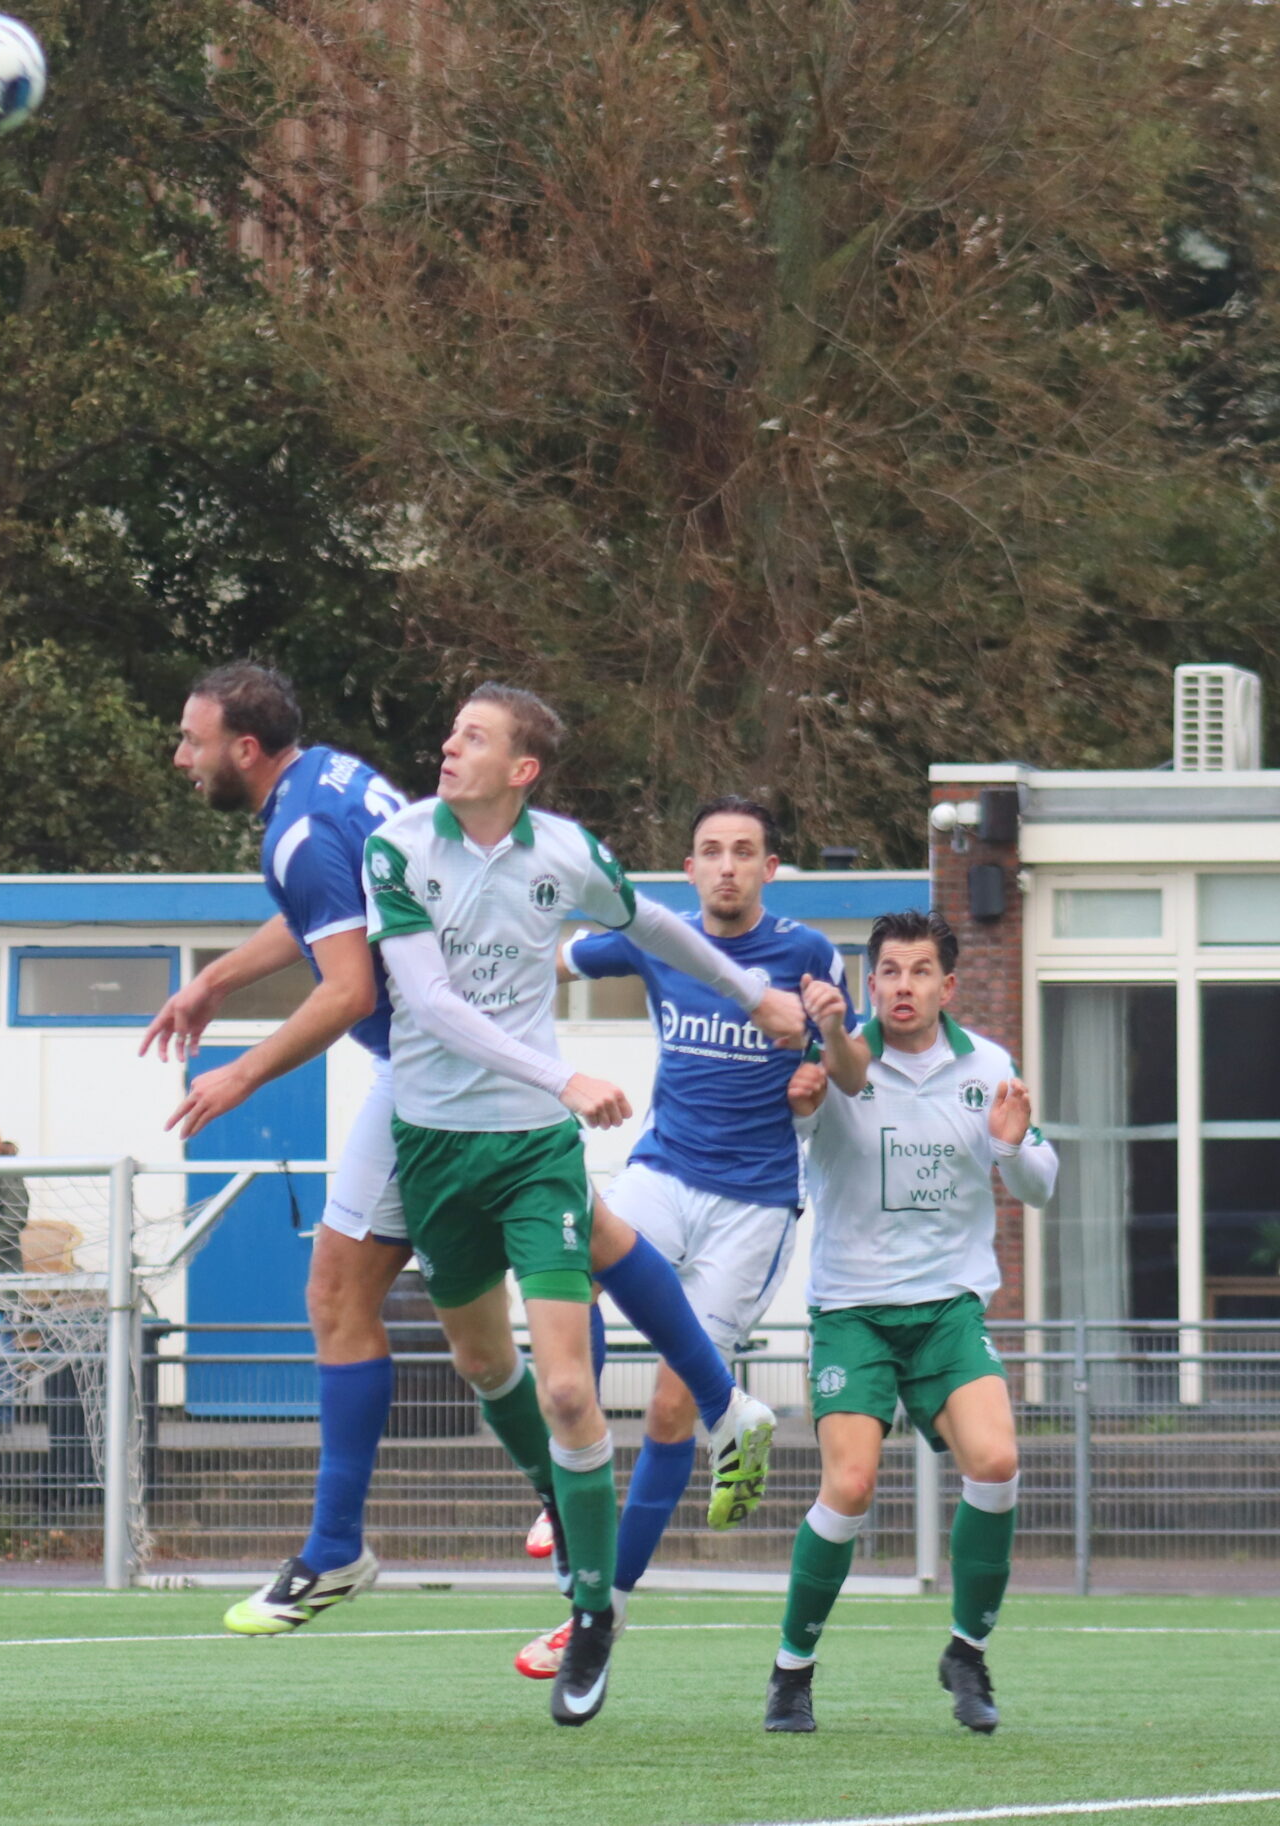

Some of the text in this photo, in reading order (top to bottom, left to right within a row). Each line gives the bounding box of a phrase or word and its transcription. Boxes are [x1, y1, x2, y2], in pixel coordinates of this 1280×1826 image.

[450, 938, 519, 960] house
[472, 962, 498, 981] of
[462, 985, 520, 1006] work
[890, 1137, 955, 1157] house
[916, 1160, 939, 1180] of
[910, 1181, 957, 1202] work
[562, 1212, 574, 1227] 3
